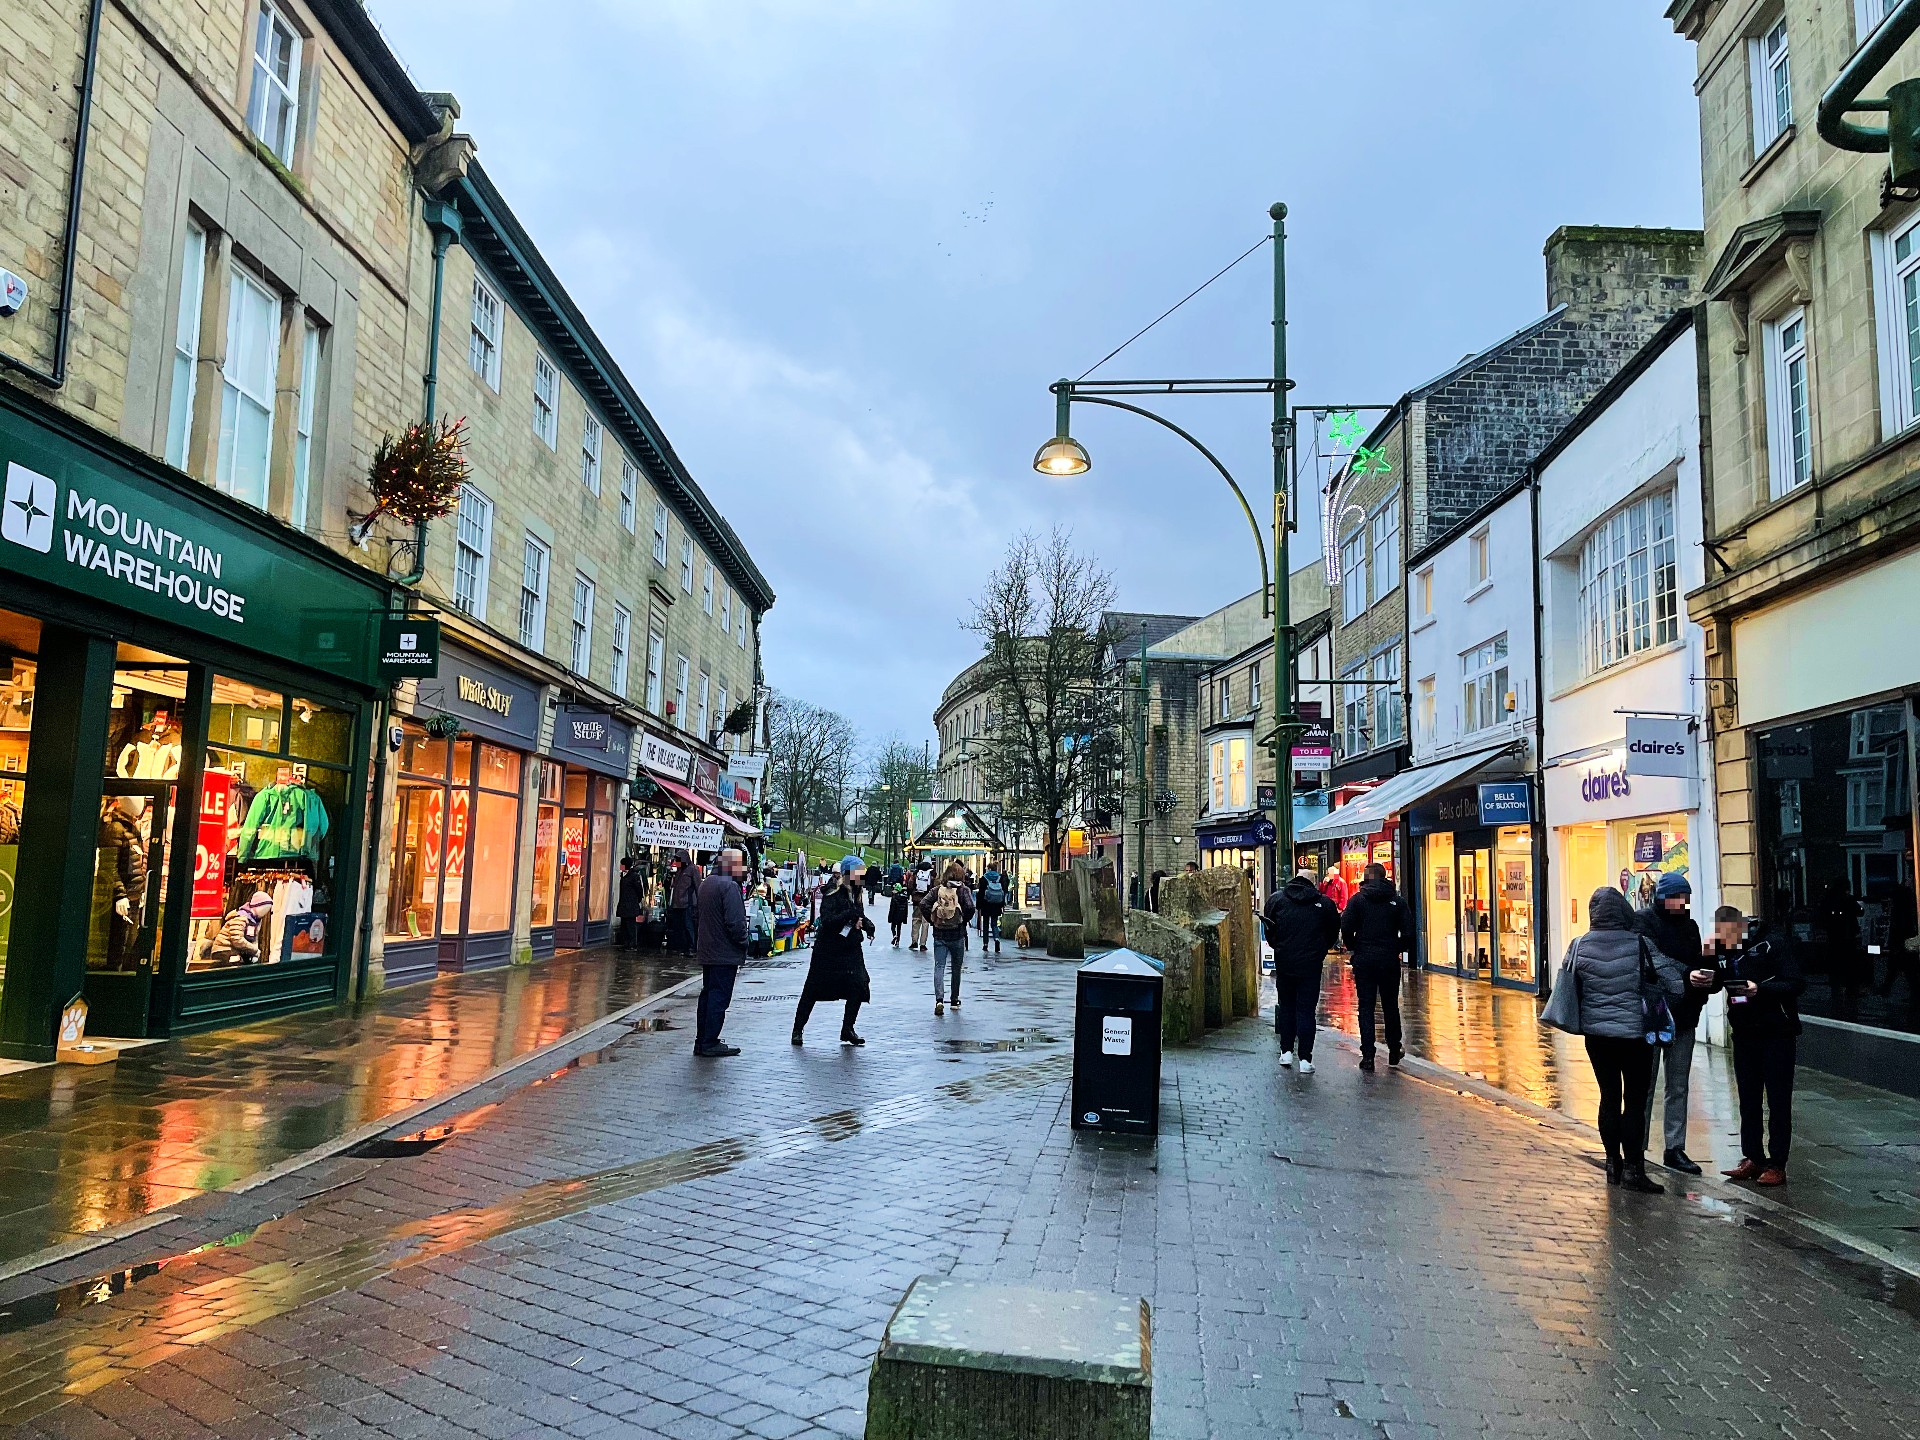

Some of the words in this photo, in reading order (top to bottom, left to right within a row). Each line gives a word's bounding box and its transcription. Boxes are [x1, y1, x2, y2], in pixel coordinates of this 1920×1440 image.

[67, 488, 223, 580] MOUNTAIN
[63, 529, 245, 624] WAREHOUSE
[1629, 739, 1685, 755] claire's
[730, 758, 746, 766] Face
[1582, 762, 1631, 802] claire's
[1494, 793, 1515, 801] BELLS
[1440, 802, 1454, 820] Bells
[1456, 798, 1463, 818] of
[1464, 798, 1479, 817] Bux
[1496, 802, 1526, 810] BUXTON
[434, 811, 464, 836] SLE
[637, 818, 655, 829] The
[658, 820, 691, 834] Village
[692, 824, 721, 835] Saver
[935, 830, 950, 838] THE
[950, 830, 986, 839] SPRINGS
[636, 835, 654, 844] Many
[656, 837, 676, 846] Items
[678, 840, 692, 849] 99p
[567, 844, 582, 853] SALE
[206, 872, 219, 880] OFF
[1510, 872, 1522, 880] SALE
[1506, 882, 1518, 891] NOW
[1104, 1028, 1130, 1036] General
[1104, 1036, 1125, 1044] Waste
